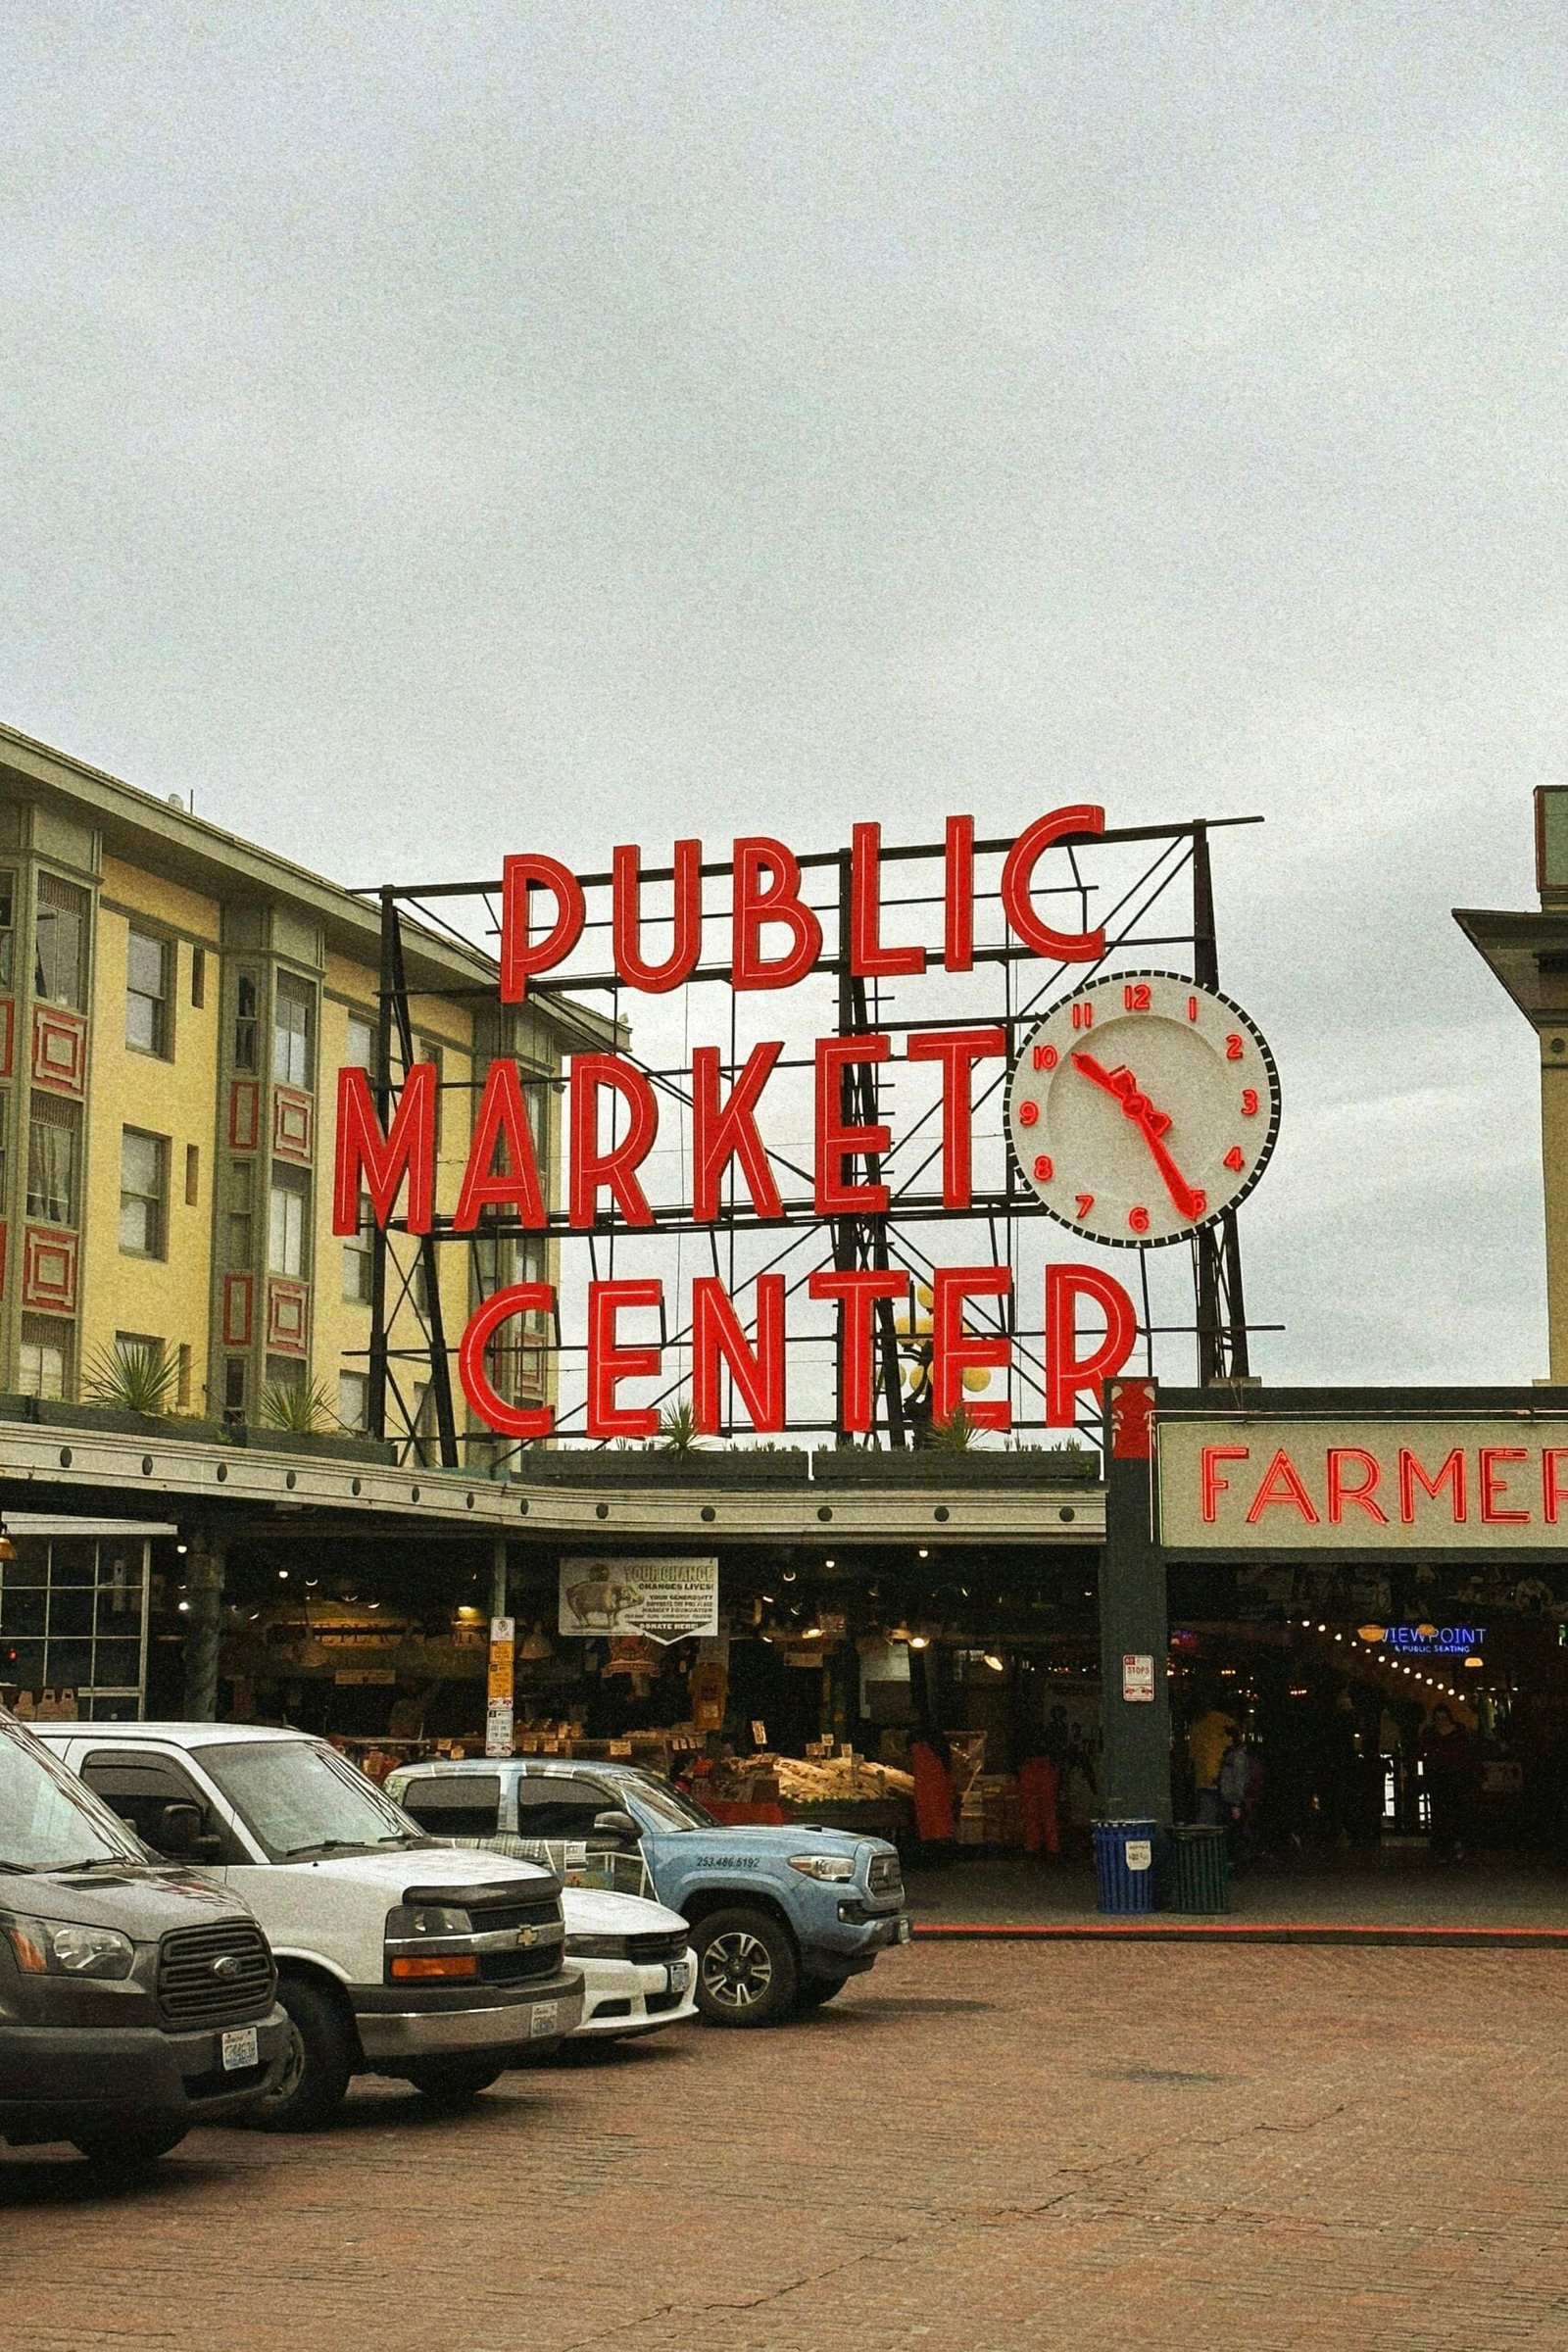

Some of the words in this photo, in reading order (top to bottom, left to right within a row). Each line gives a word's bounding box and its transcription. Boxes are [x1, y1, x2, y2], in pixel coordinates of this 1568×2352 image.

[500, 804, 1106, 1004] PUBLIC
[1123, 983, 1152, 1010] 12
[1187, 997, 1198, 1021] 1
[1071, 1003, 1094, 1029] 11
[1032, 1045, 1059, 1070] 10
[1225, 1033, 1244, 1060] 2
[1018, 1101, 1040, 1127] 9
[1241, 1088, 1259, 1116] 3
[331, 1026, 1007, 1236] MARKET
[1033, 1154, 1054, 1182] 8
[1223, 1146, 1245, 1172] 4
[1075, 1194, 1095, 1219] 7
[1190, 1190, 1207, 1215] 5
[1127, 1206, 1150, 1234] 6
[458, 1262, 1137, 1441] CENTER
[624, 1565, 660, 1583] YOUR
[661, 1565, 714, 1583] CHANGE
[1381, 1627, 1487, 1643] VIEWPOINT
[696, 1856, 760, 1869] 253.486.5192
